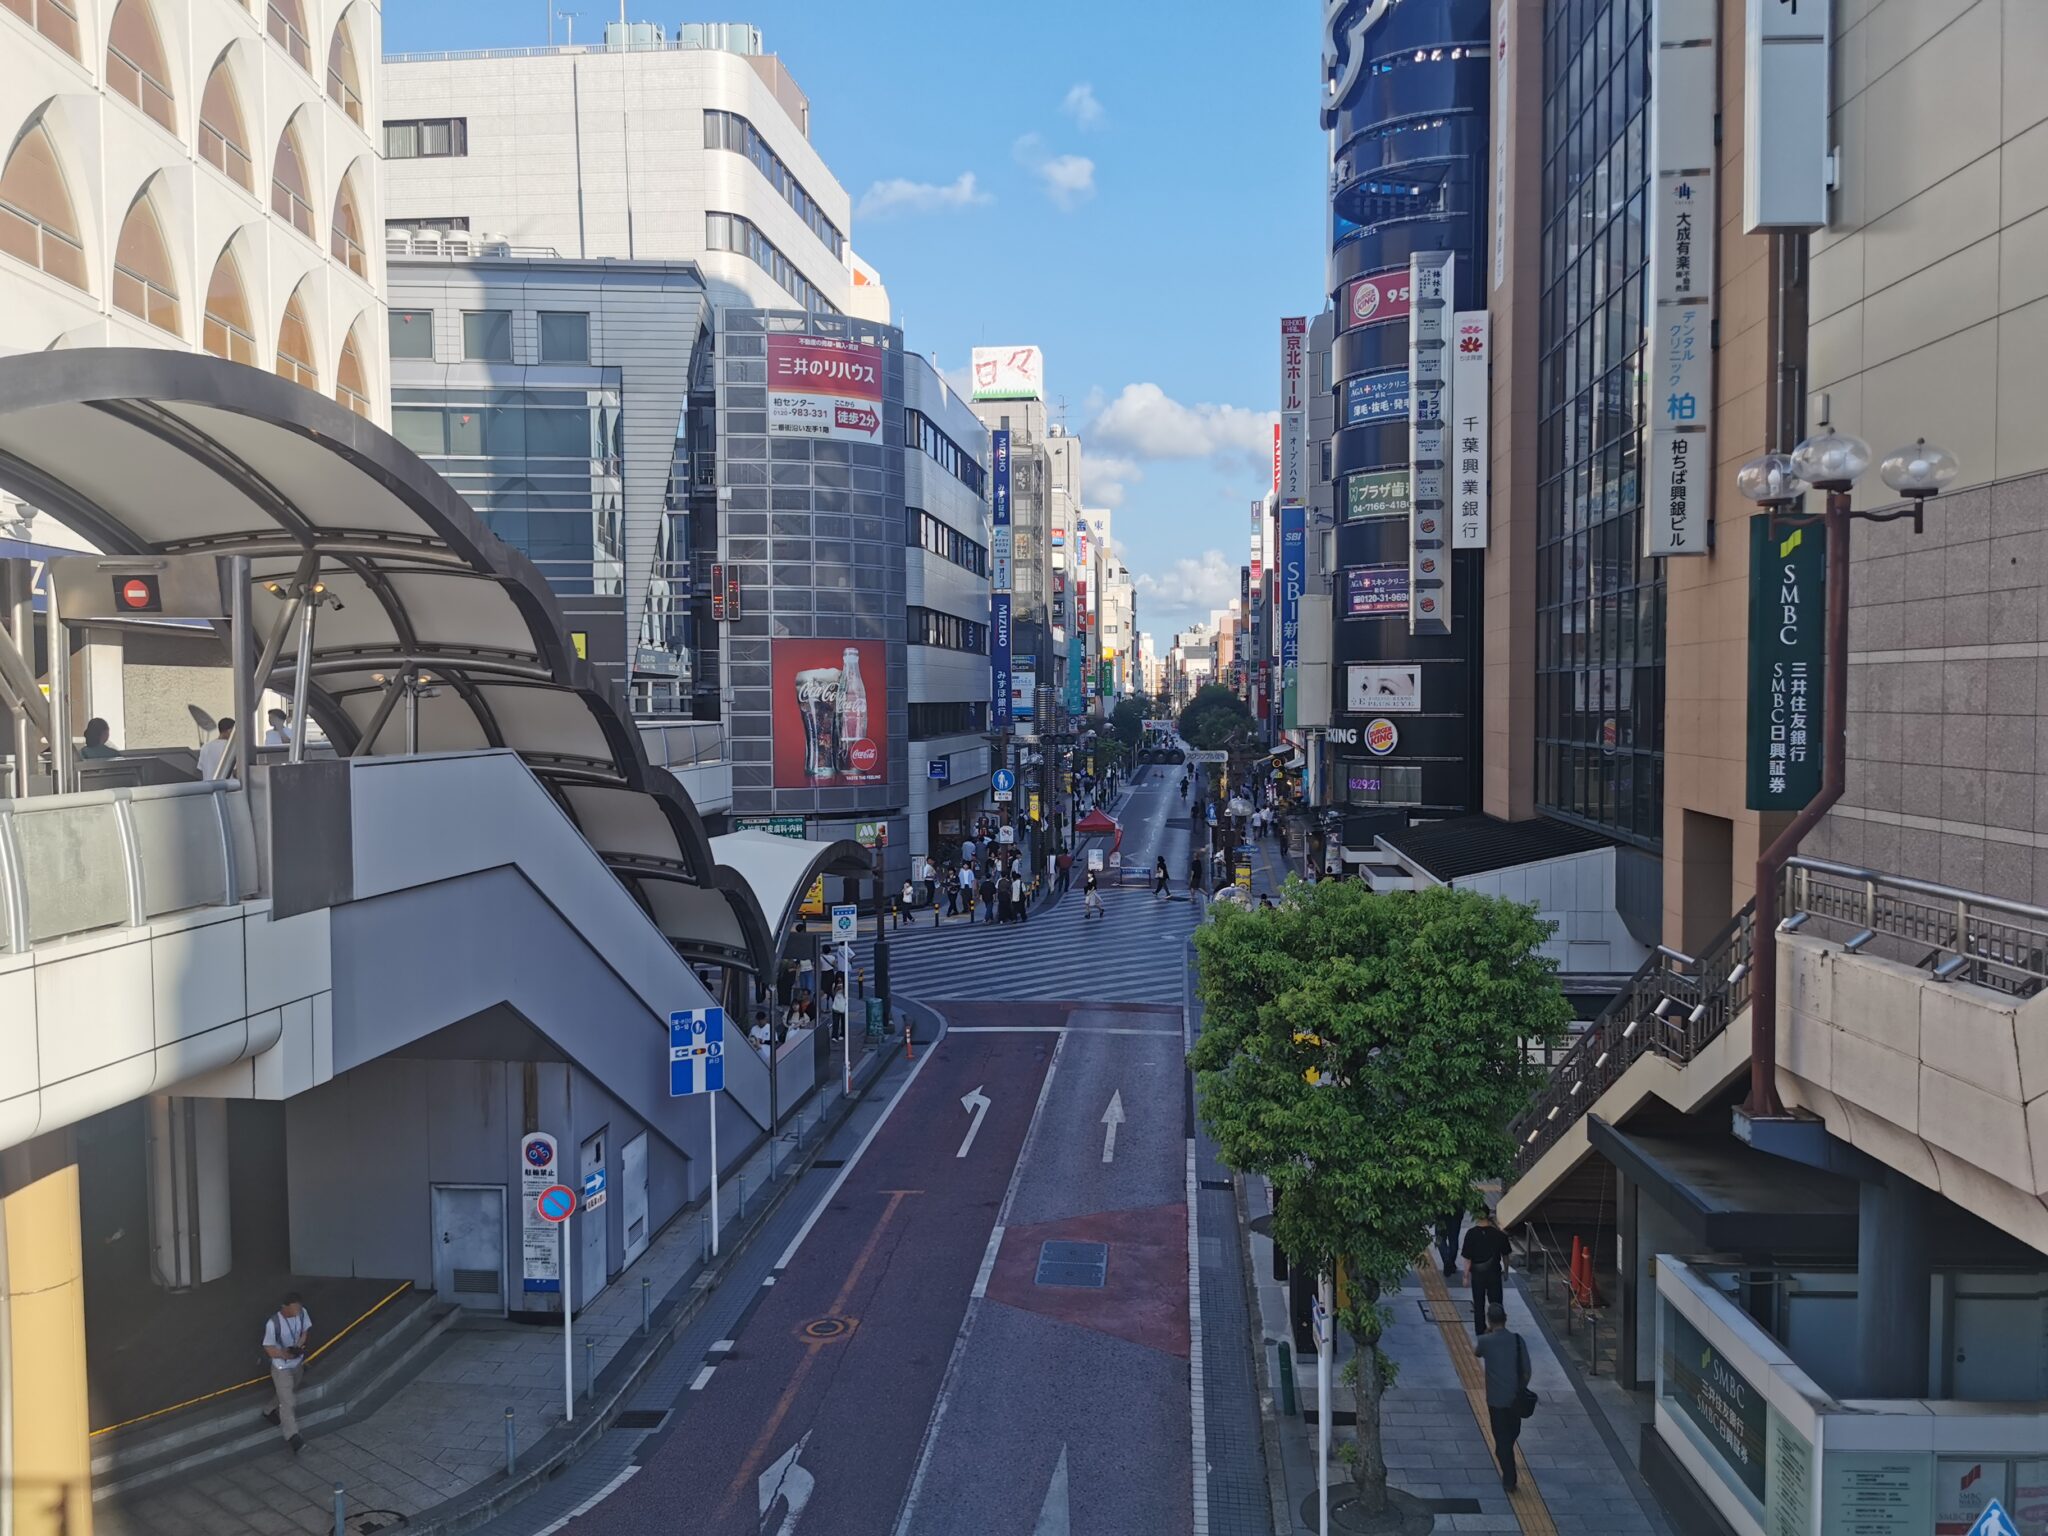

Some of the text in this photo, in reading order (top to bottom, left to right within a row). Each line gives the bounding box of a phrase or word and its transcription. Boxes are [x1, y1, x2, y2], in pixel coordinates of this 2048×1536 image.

[1676, 212, 1691, 270] 大成有楽
[1683, 311, 1696, 360] デンタル
[778, 358, 875, 384] 三井のリハウス
[1287, 336, 1301, 409] 京北ホール
[1665, 325, 1681, 386] クリニック
[774, 398, 815, 407] 柏センター
[1372, 380, 1409, 391] スキンクリニ
[774, 408, 828, 417] 0120-983-331
[835, 400, 855, 408] ここから
[837, 410, 875, 428] 徒歩2分
[1418, 400, 1428, 419] 歯科
[1429, 391, 1439, 420] プラザ
[1667, 393, 1695, 420] 柏
[998, 437, 1007, 473] MIZUHO
[1289, 437, 1298, 493] オープンハウス
[1462, 416, 1479, 539] 千葉興業銀行
[1669, 439, 1688, 547] 柏ちば興銀ビル
[1285, 532, 1302, 541] SBI
[1360, 593, 1409, 603] 0120-31-969
[1372, 578, 1408, 586] スキンクリニ
[1780, 564, 1800, 645] SMBC
[998, 604, 1007, 647] MIZUHO
[997, 671, 1007, 717] みずほ銀行
[1790, 662, 1807, 762] 三井住友銀行
[1370, 726, 1392, 737] BURGER
[1371, 732, 1393, 746] KING
[1769, 663, 1786, 793] SMBC日興証券
[853, 748, 875, 759] Coca-Cola
[1713, 1359, 1745, 1409] SMBC
[1701, 1378, 1745, 1437] 三井住友銀行
[1696, 1394, 1749, 1465] SMBC日興証券
